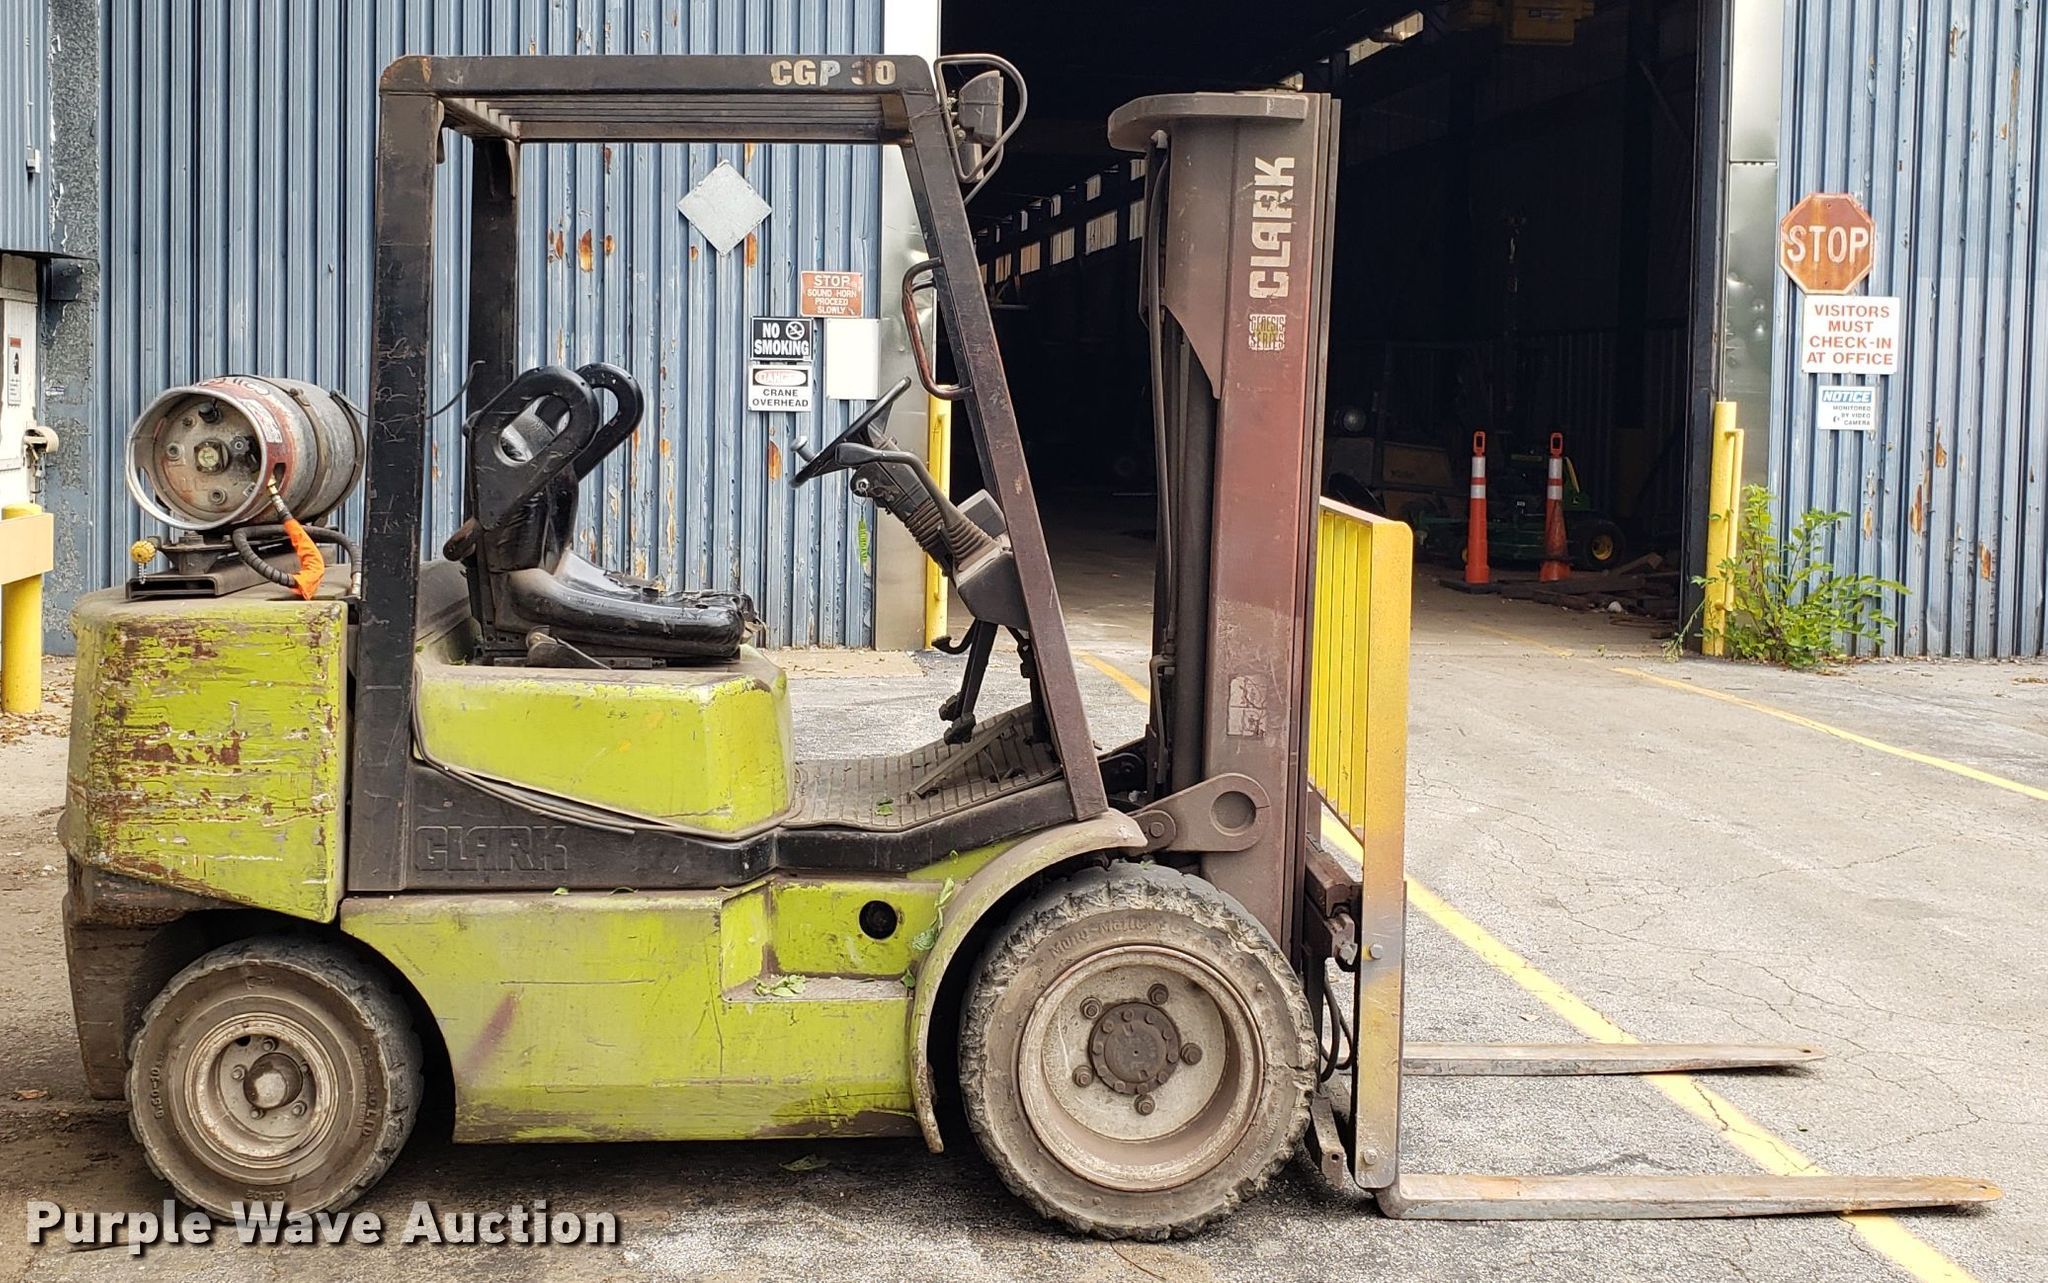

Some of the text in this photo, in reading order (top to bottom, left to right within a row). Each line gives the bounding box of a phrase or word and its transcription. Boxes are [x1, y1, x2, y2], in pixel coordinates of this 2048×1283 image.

[771, 60, 841, 87] CGP
[1249, 156, 1295, 299] CLARK
[1787, 225, 1869, 264] STOP
[814, 275, 851, 287] STOP
[807, 289, 857, 297] SOUND HORN
[815, 298, 848, 306] PROCEED
[817, 306, 846, 314] SLOWLY
[1814, 304, 1890, 317] VISITORS
[762, 322, 780, 339] NO
[1828, 320, 1874, 333] MUST
[754, 339, 809, 356] SMOKING
[1809, 335, 1892, 349] CHECK-IN
[1806, 352, 1893, 365] AT OFFICE
[763, 388, 798, 397] CRANE
[1822, 390, 1872, 403] NOTICE
[752, 399, 809, 407] OVERHEAD
[415, 826, 567, 871] CLARK
